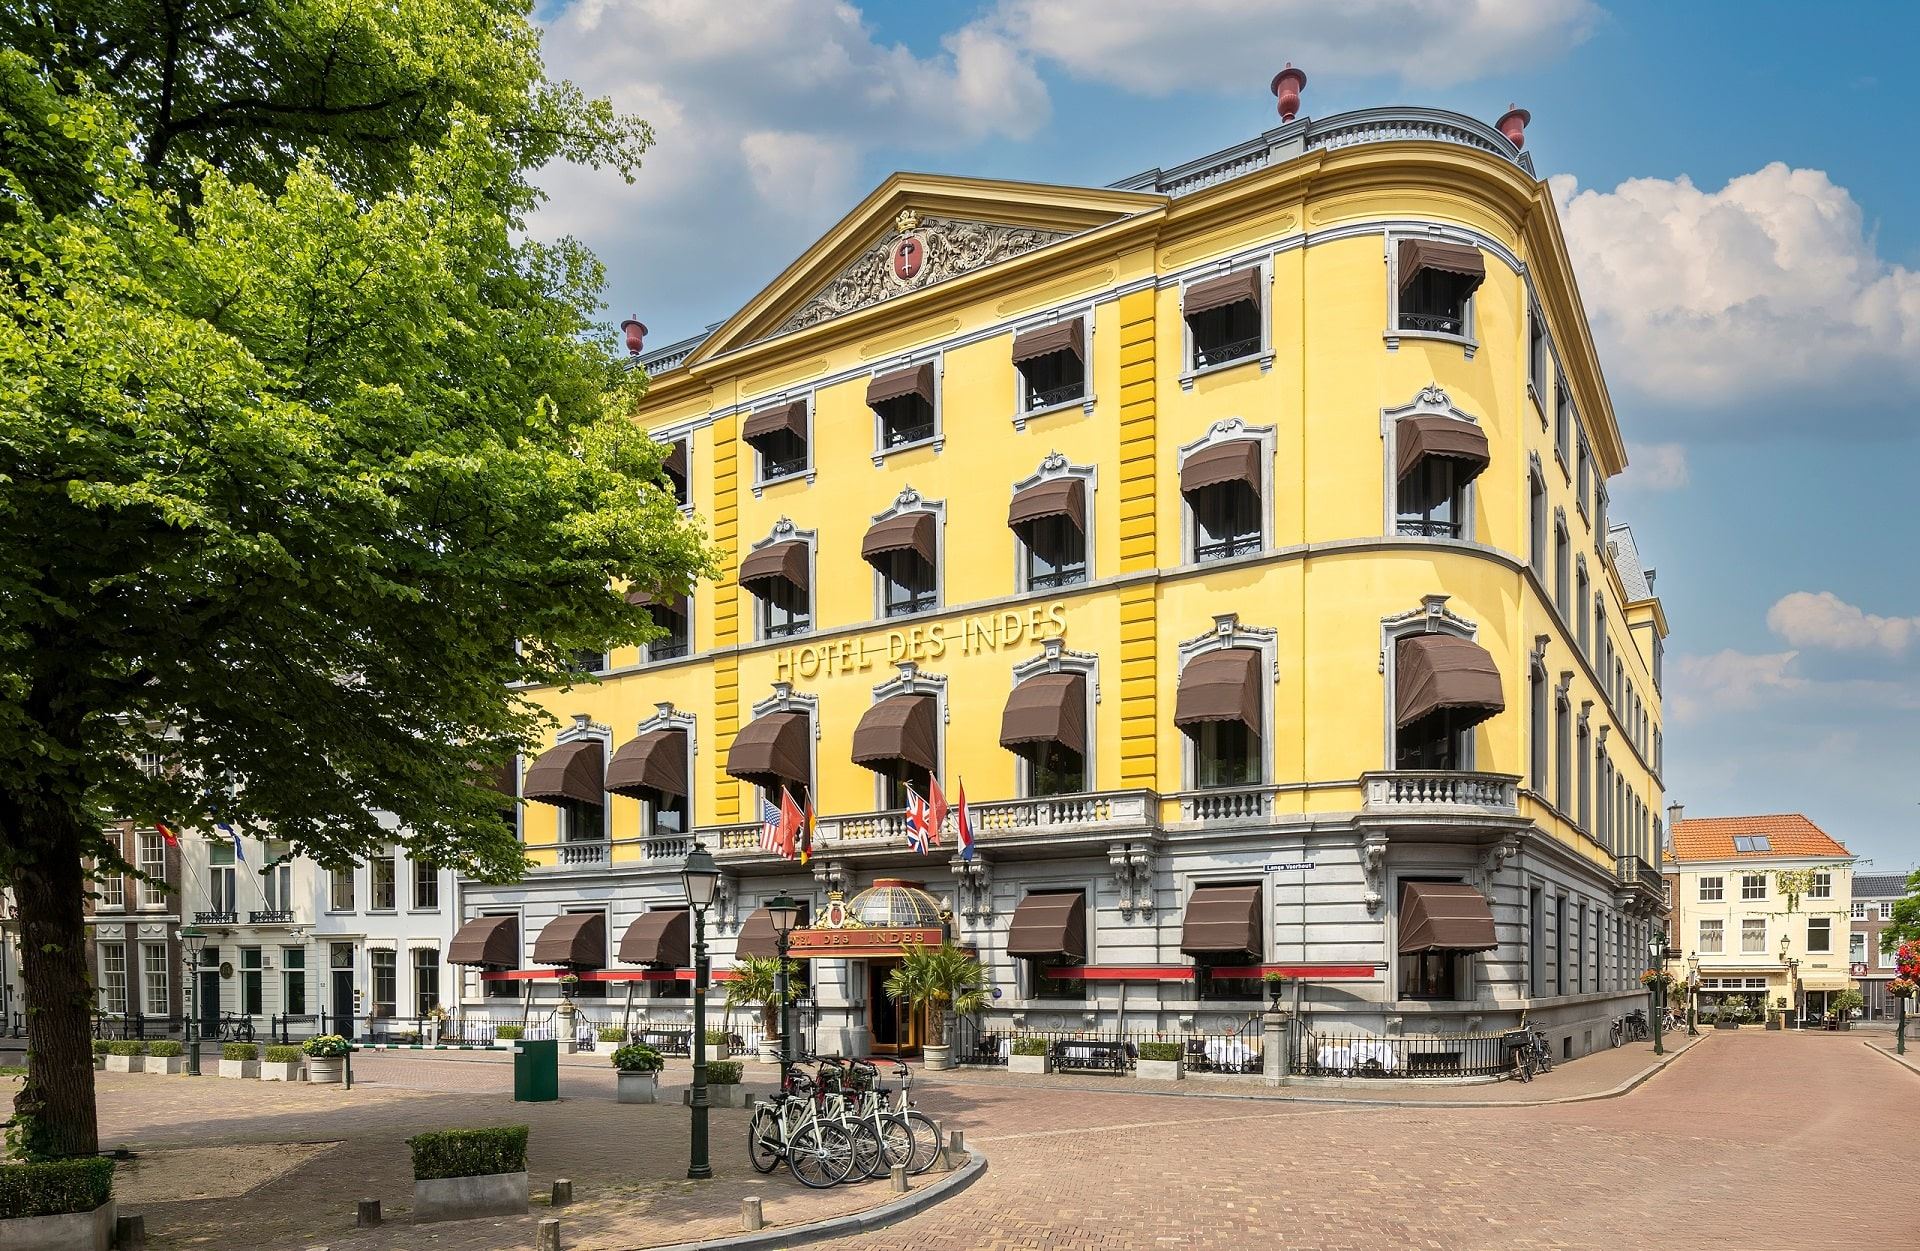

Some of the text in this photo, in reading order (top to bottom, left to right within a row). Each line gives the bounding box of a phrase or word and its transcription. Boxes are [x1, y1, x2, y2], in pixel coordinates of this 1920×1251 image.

[775, 602, 1068, 681] HOTEL DES INDES
[823, 935, 850, 945] DES
[868, 932, 924, 944] INDES
